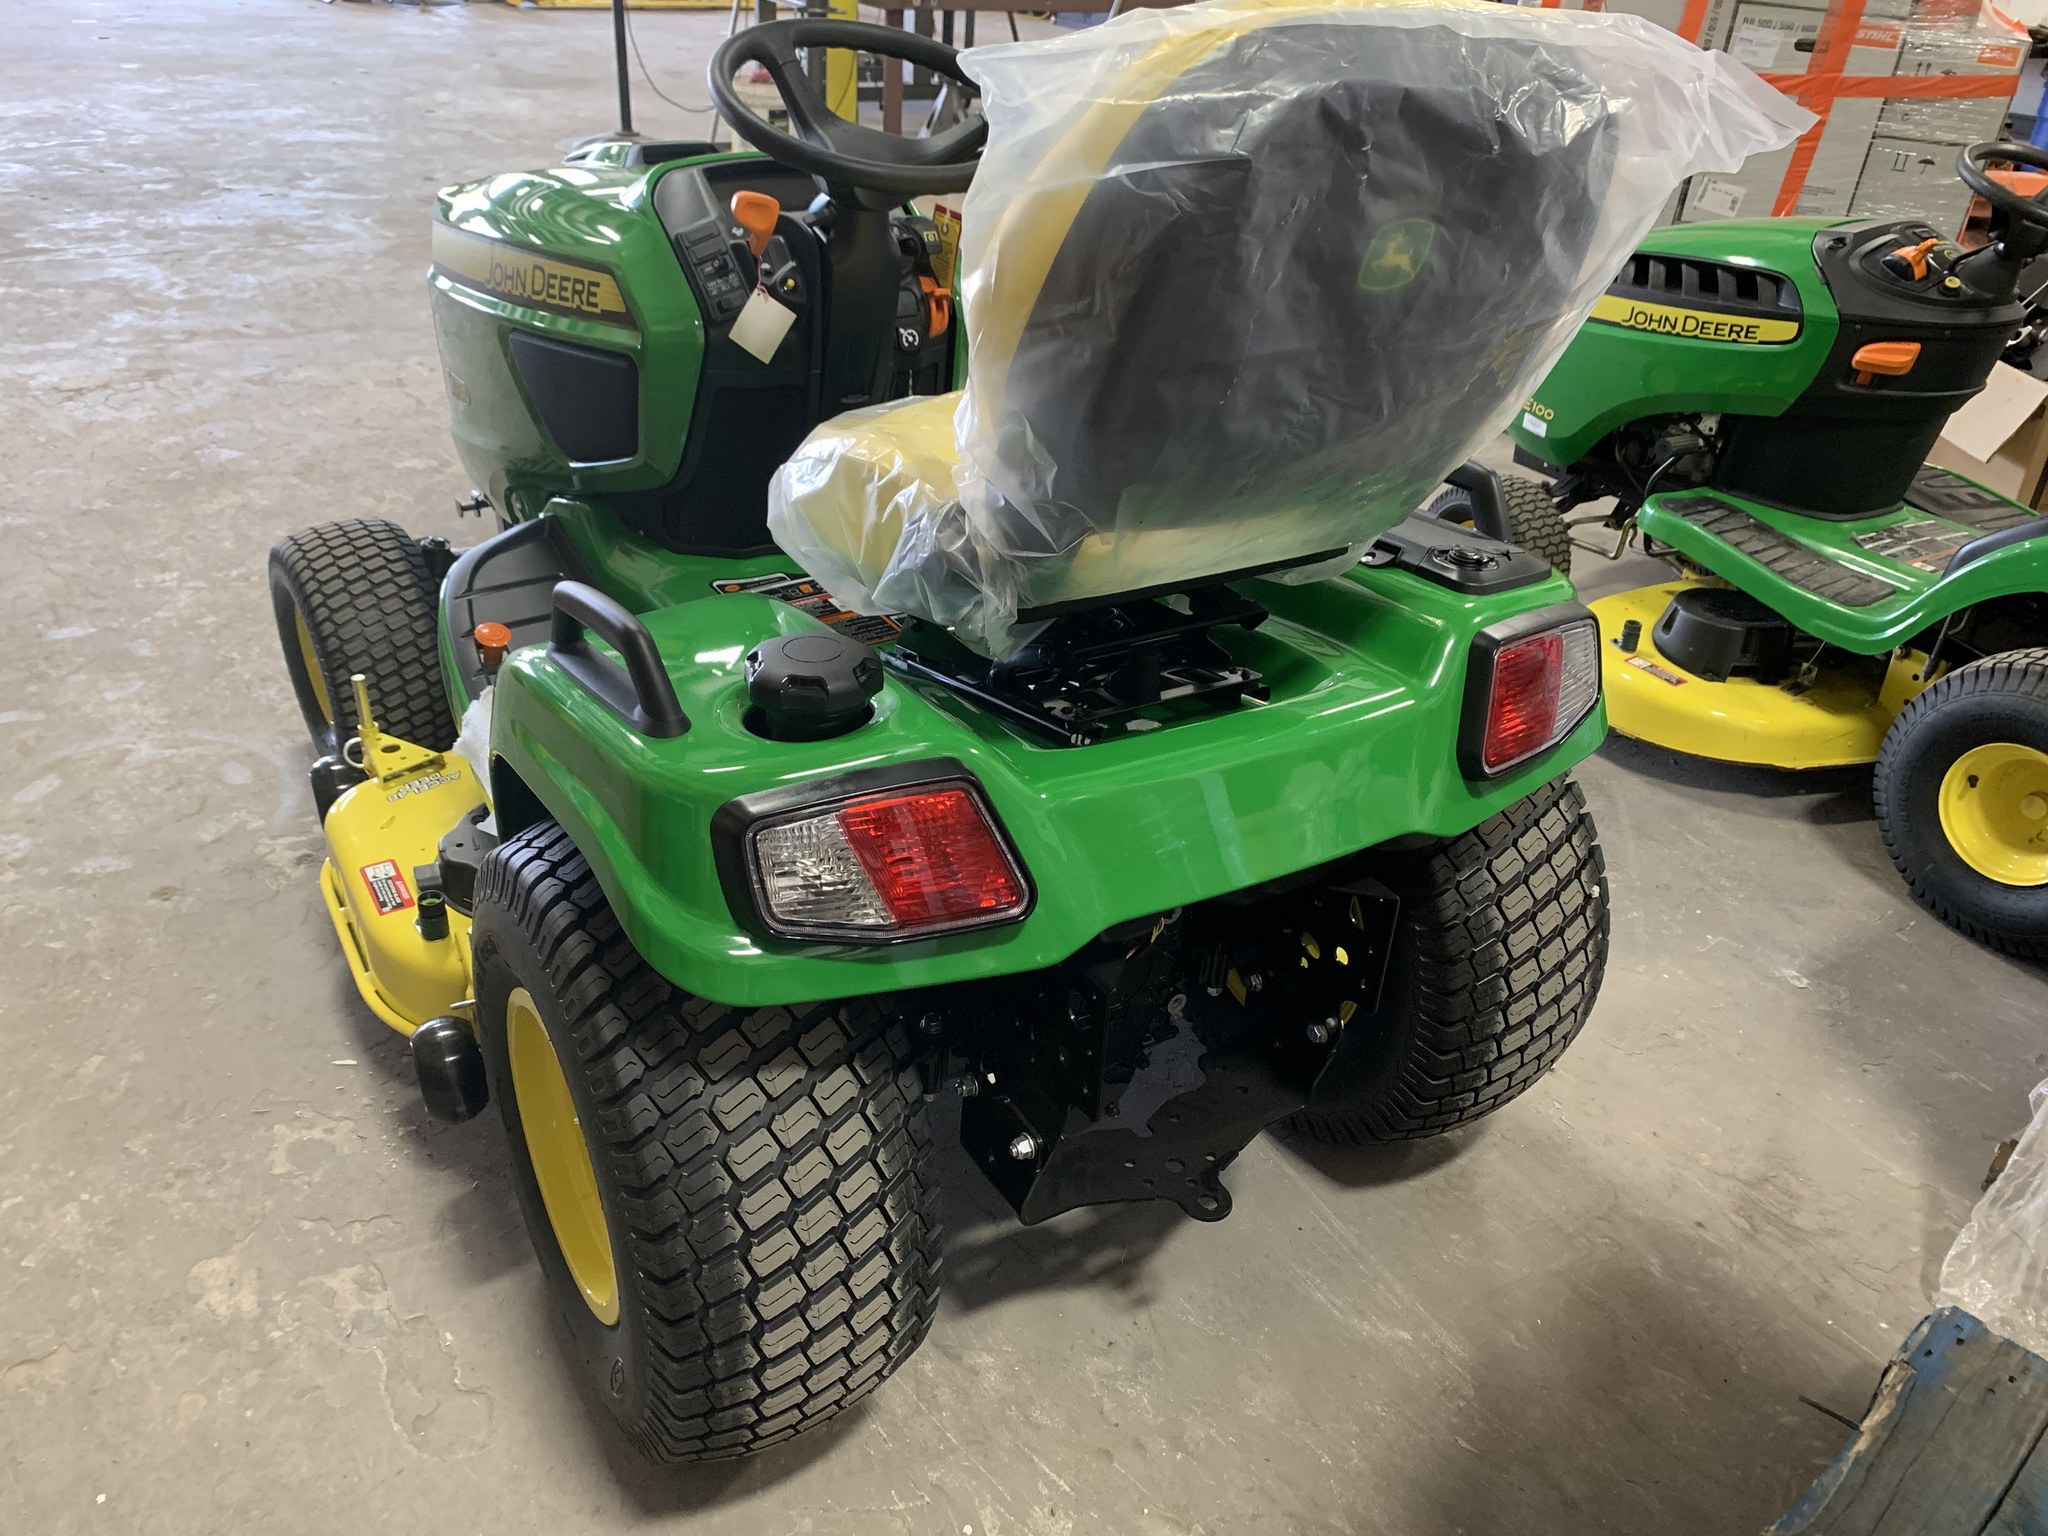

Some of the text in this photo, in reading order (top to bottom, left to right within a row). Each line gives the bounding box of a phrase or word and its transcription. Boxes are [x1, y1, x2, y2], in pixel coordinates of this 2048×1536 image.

[1855, 29, 1895, 42] STIHL
[484, 253, 601, 308] JOHN DEERE
[1622, 306, 1761, 340] JOHN DEERE
